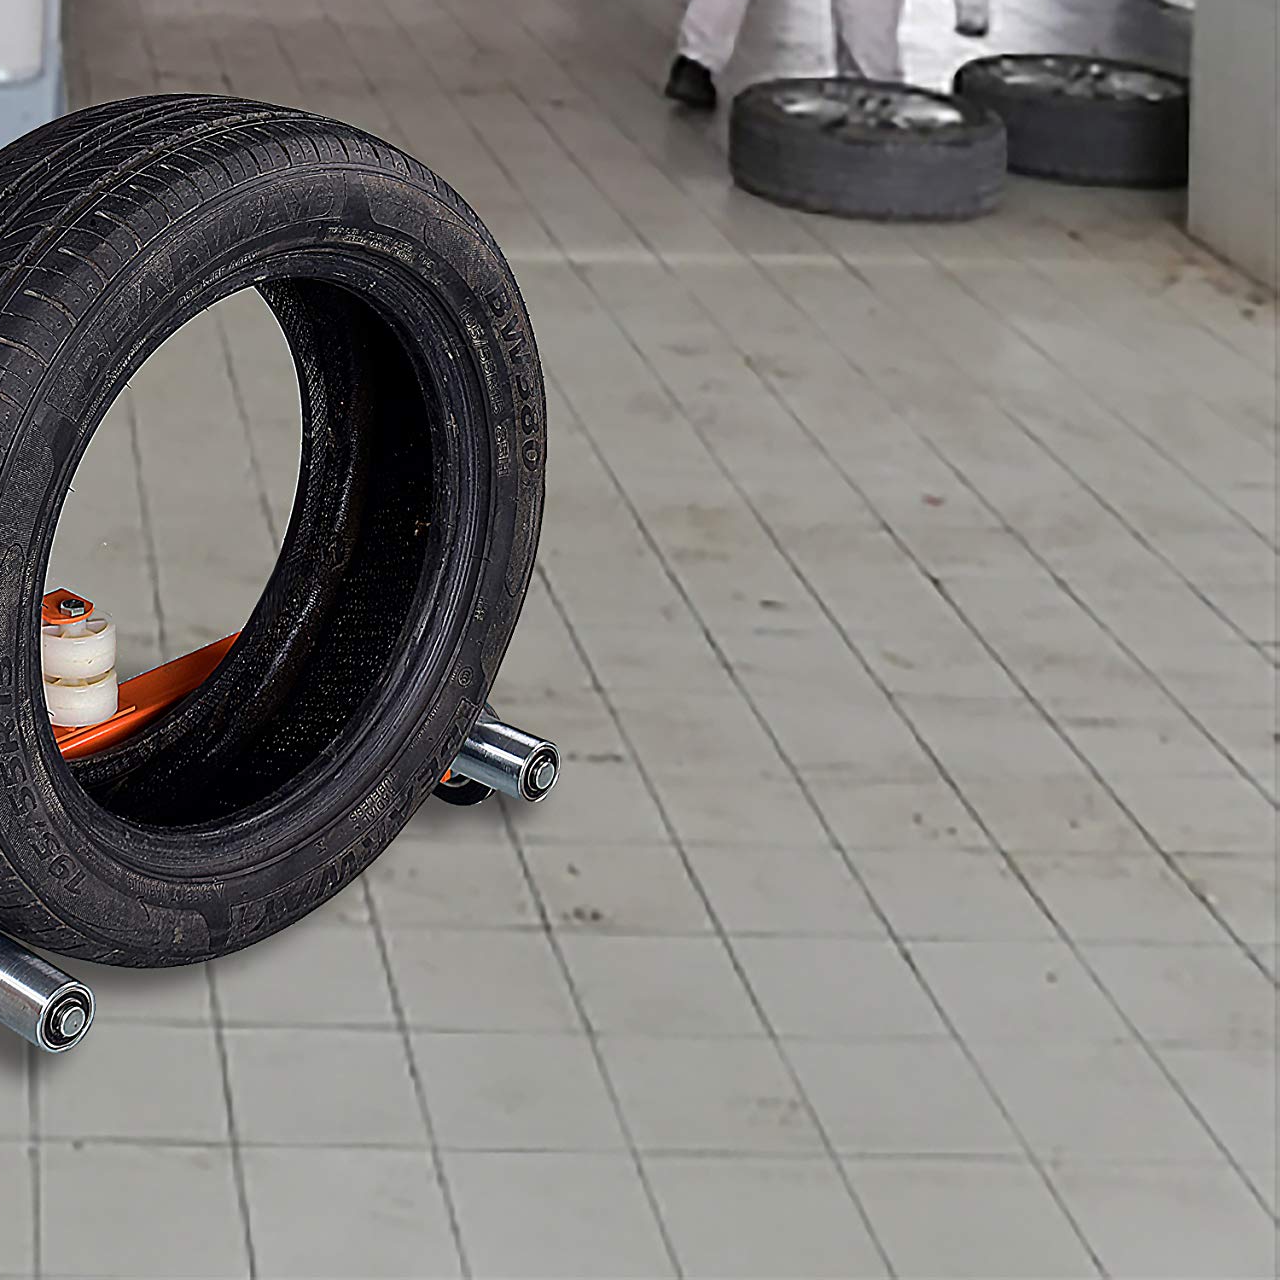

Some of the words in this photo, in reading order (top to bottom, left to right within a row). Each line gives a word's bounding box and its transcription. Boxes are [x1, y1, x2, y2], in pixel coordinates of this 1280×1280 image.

[486, 278, 539, 473] BW380
[348, 772, 396, 824] TUBELESS
[361, 784, 396, 827] RADIAL
